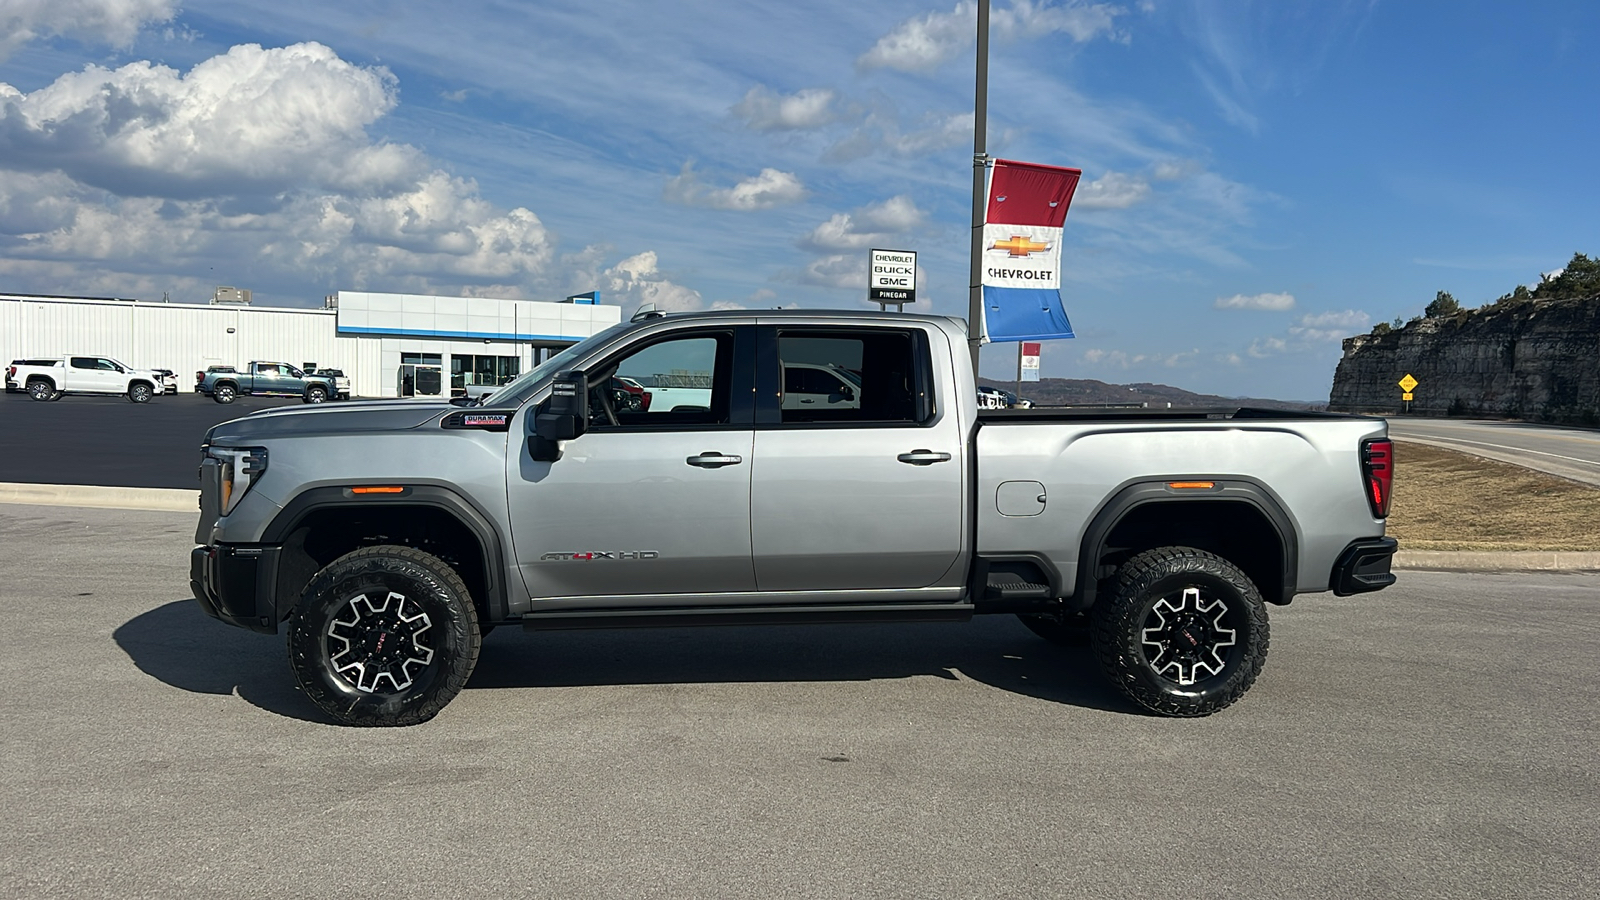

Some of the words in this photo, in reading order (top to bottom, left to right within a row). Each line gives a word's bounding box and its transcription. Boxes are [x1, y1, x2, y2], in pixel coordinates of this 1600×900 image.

[876, 254, 912, 263] CHEVROLET
[874, 266, 912, 274] BUICK
[988, 268, 1052, 280] CHEVROLET
[880, 278, 908, 286] GMC
[540, 551, 614, 561] AT4X
[620, 550, 658, 560] HD
